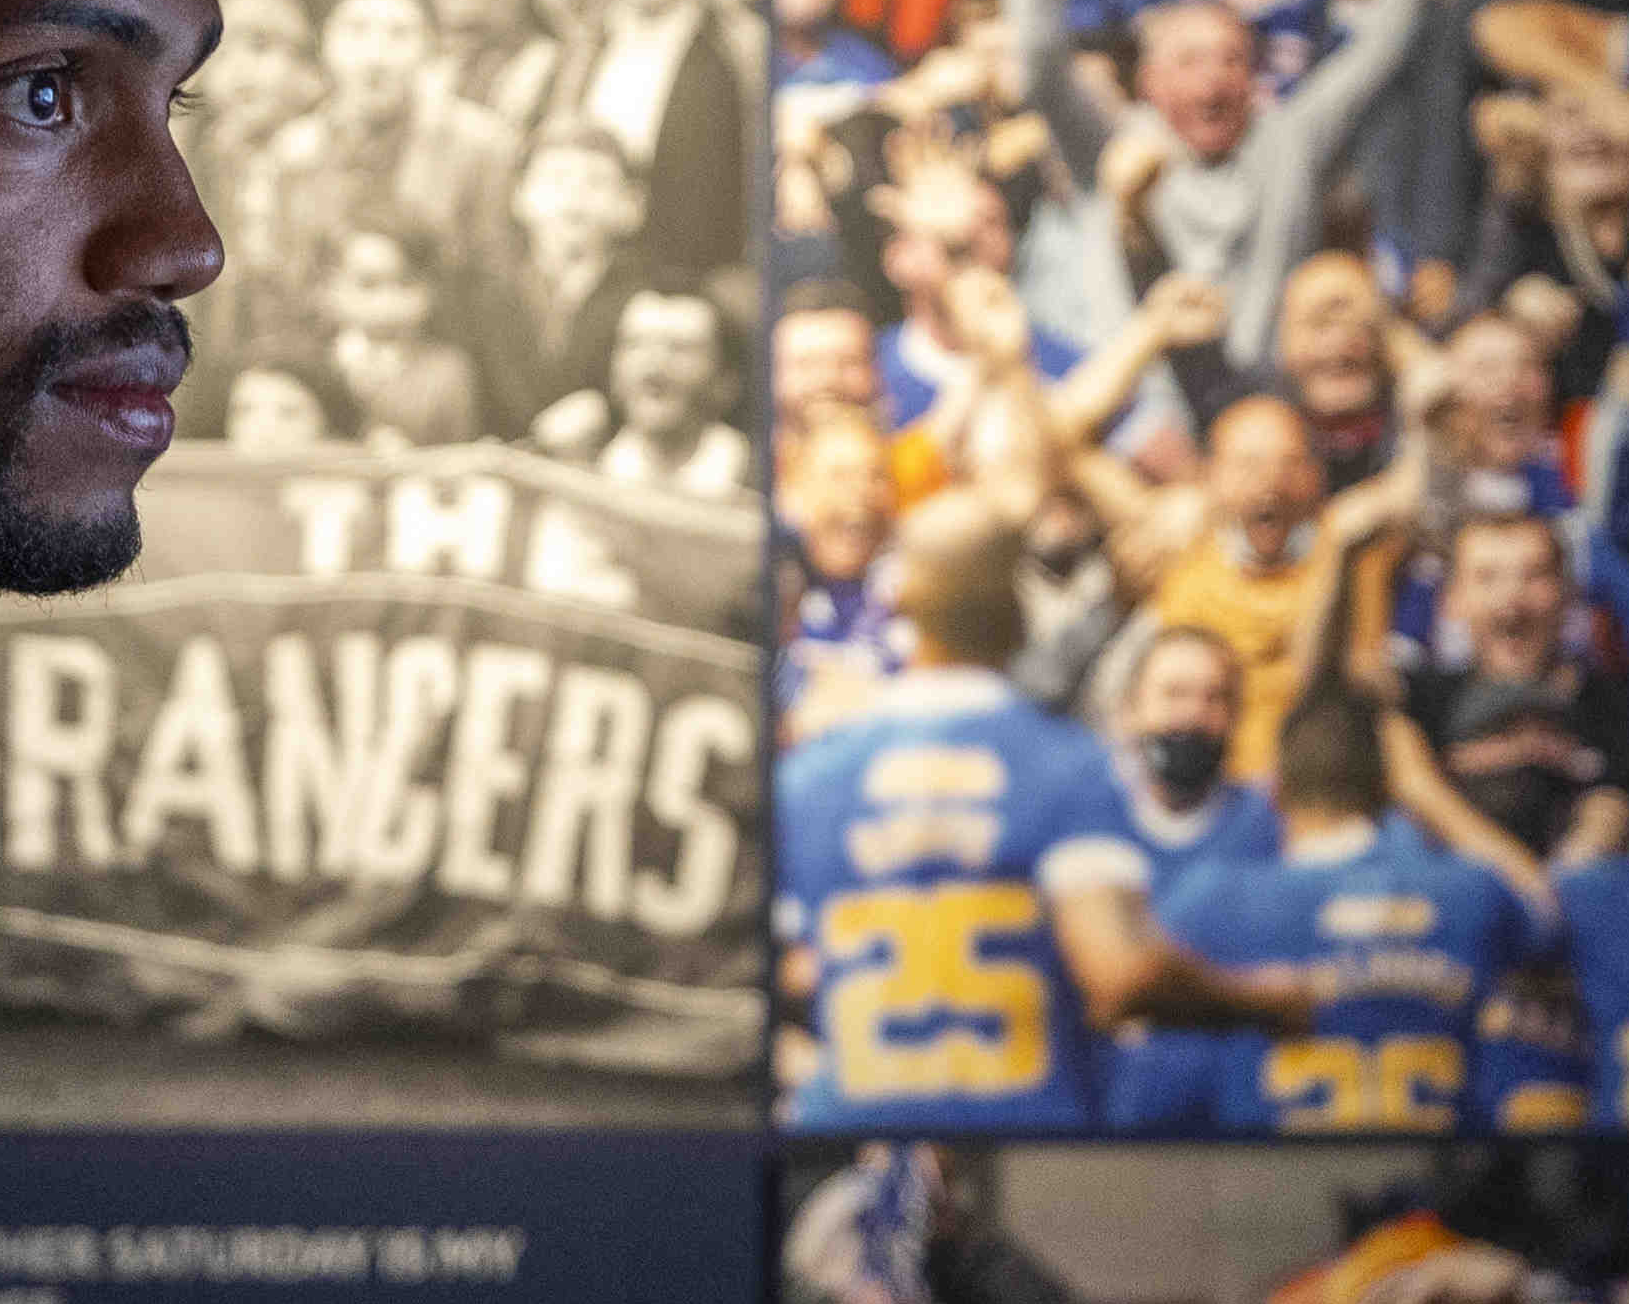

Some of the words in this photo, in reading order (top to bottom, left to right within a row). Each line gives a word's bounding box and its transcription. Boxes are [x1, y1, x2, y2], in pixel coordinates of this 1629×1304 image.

[4, 631, 761, 939] RANGERS
[821, 880, 1053, 1101] 25
[107, 1224, 368, 1282] SATURDAY
[432, 1224, 528, 1282] MY
